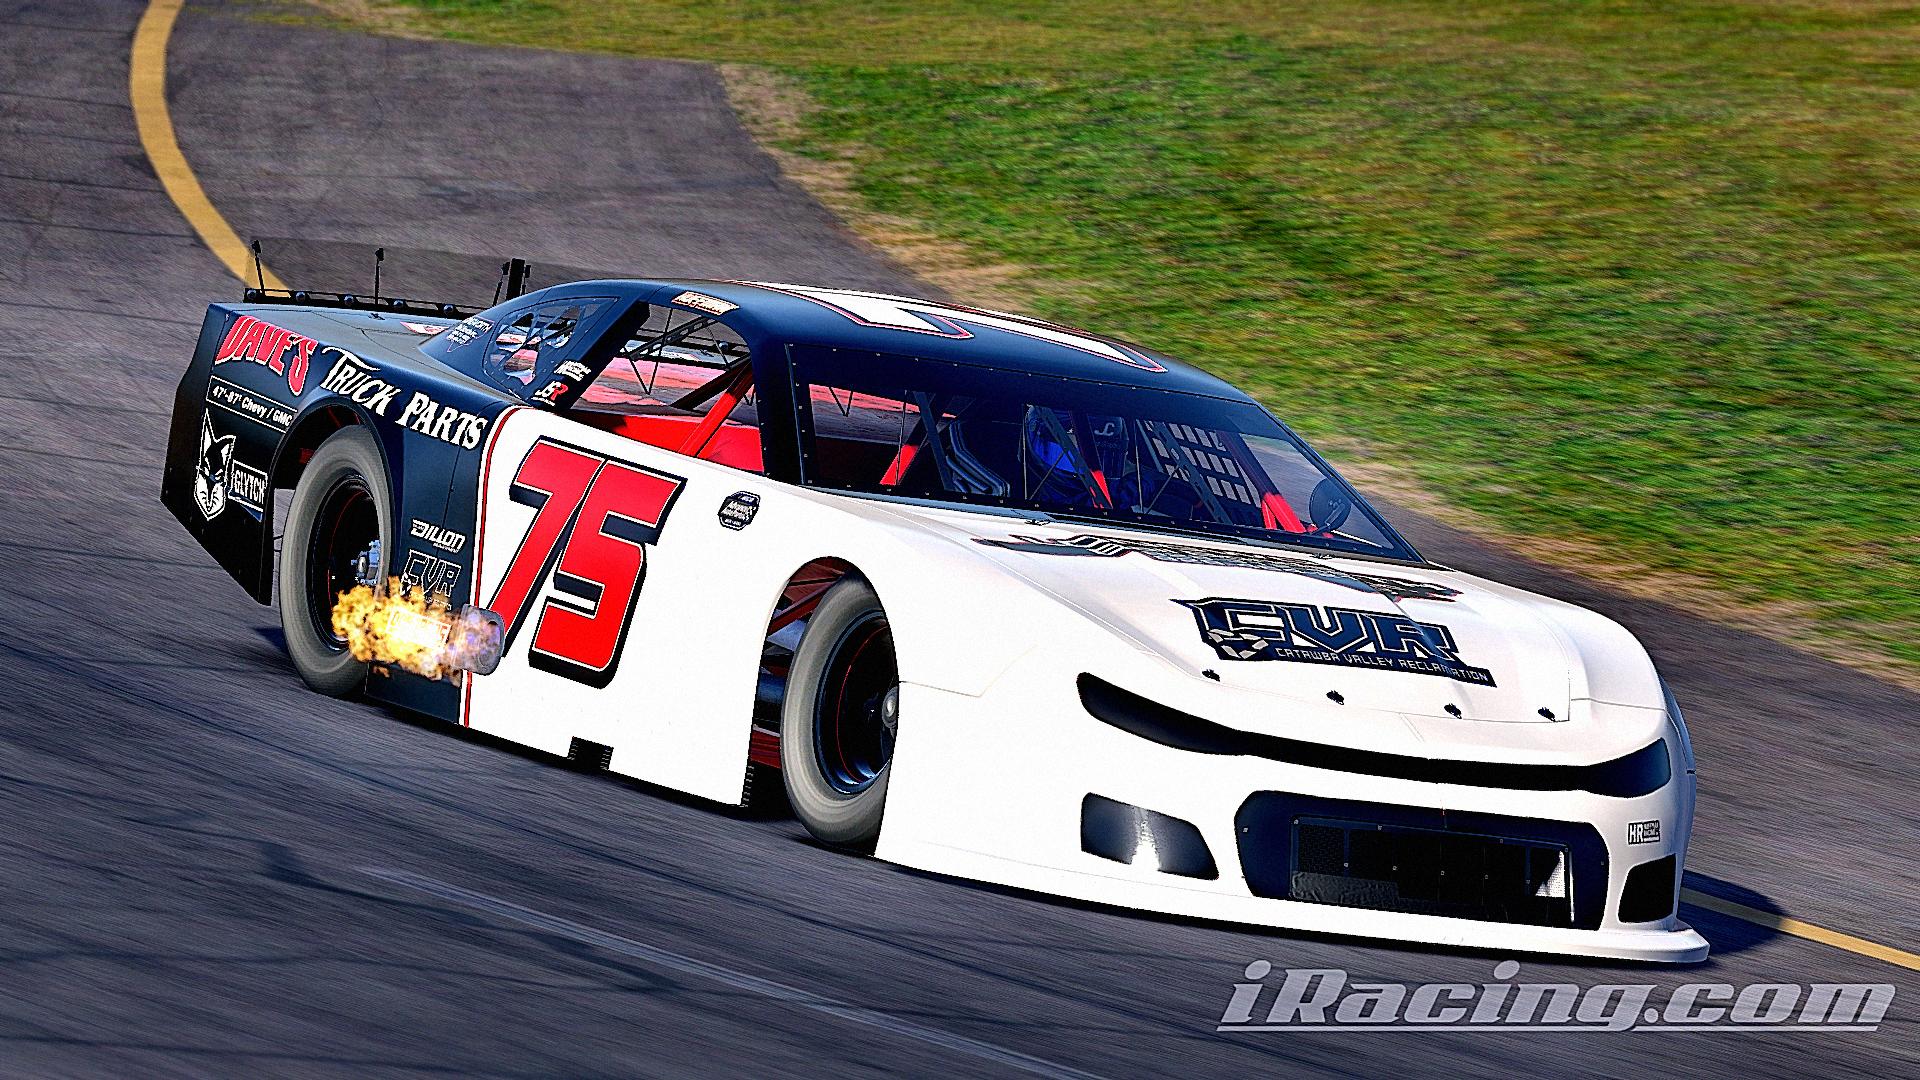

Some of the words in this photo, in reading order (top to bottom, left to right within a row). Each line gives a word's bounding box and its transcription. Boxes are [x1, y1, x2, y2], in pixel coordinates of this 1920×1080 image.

[214, 316, 319, 397] DAVE'S
[241, 396, 267, 420] Chevy
[273, 407, 293, 427] GMC
[320, 346, 401, 417] TRUCK
[395, 391, 489, 450] PARTS
[233, 469, 267, 505] GLYTCH
[400, 549, 462, 598] CVR
[486, 436, 688, 689] 75
[1197, 598, 1459, 663] CVR
[1274, 647, 1341, 662] CATAWBA
[1342, 653, 1394, 666] VALLEY
[1398, 658, 1489, 682] RECLAMATION
